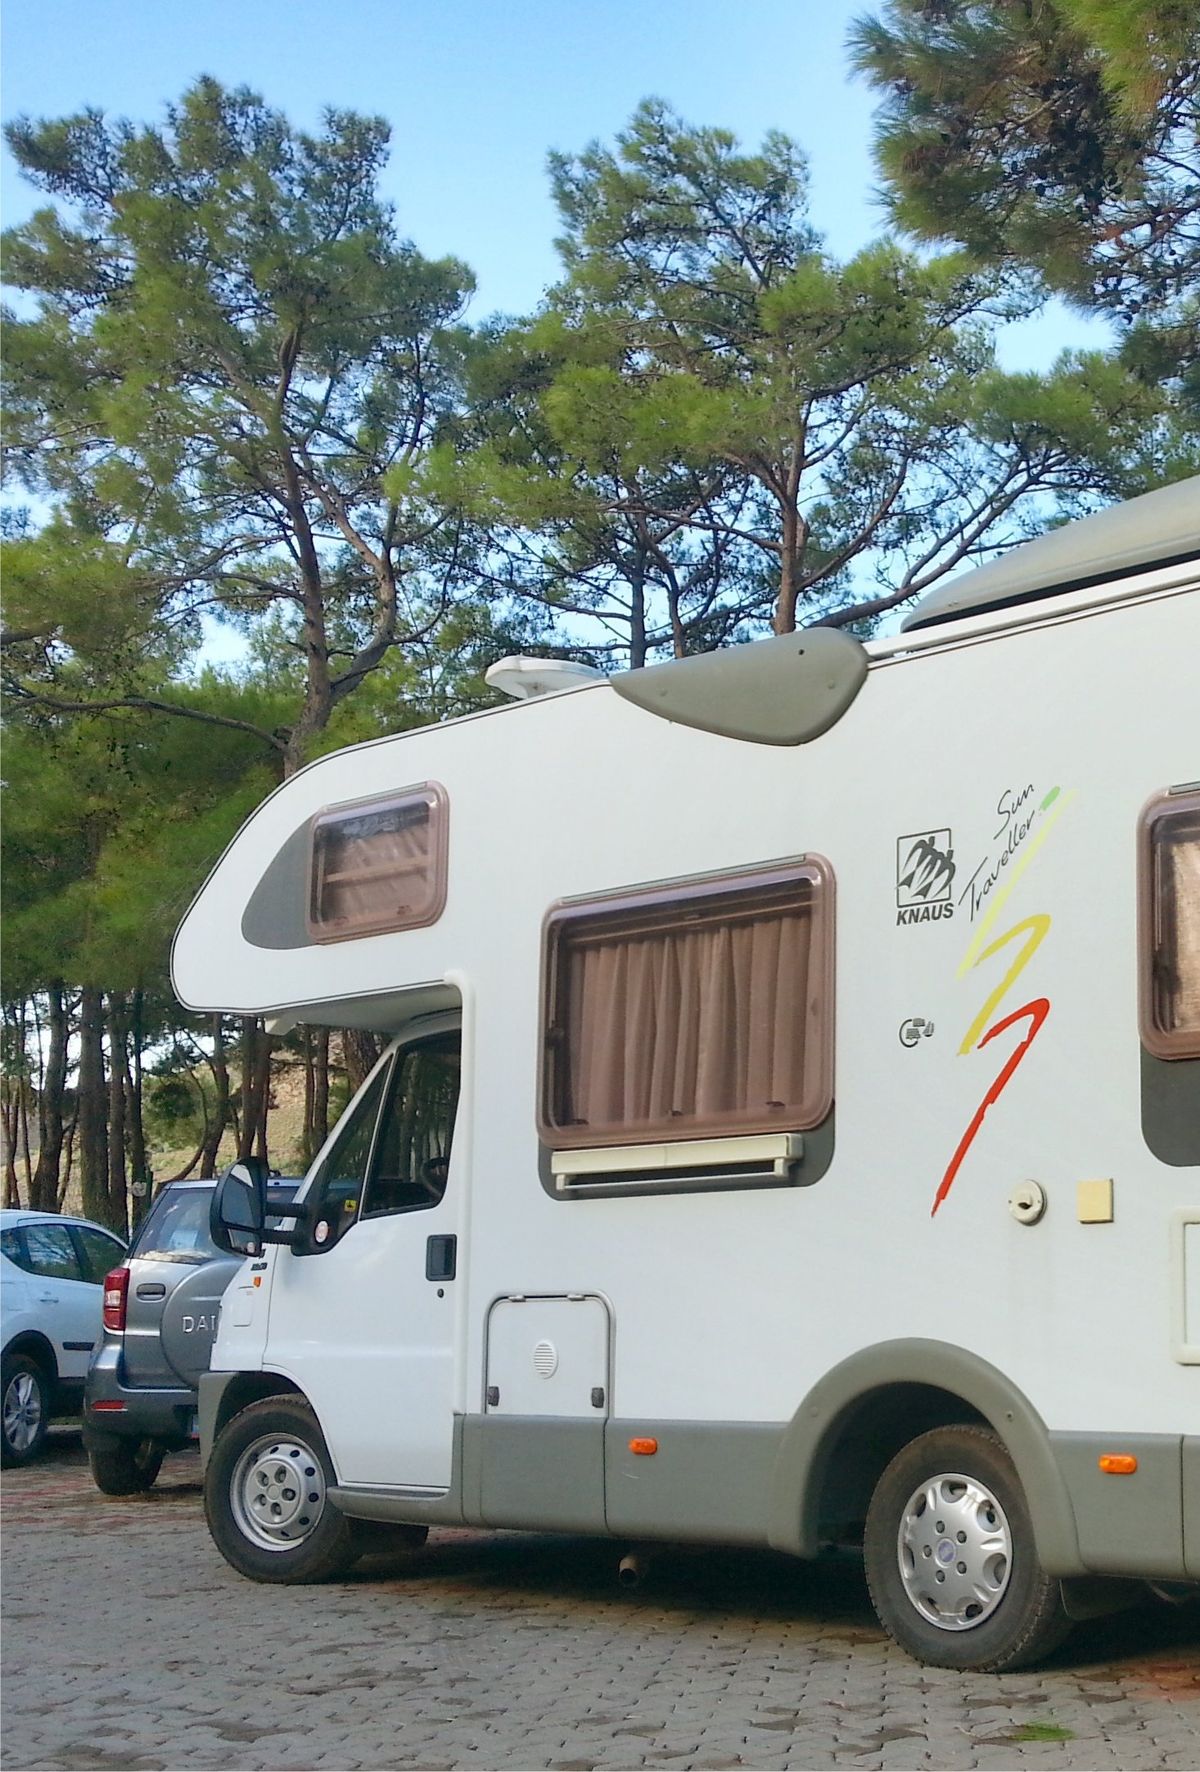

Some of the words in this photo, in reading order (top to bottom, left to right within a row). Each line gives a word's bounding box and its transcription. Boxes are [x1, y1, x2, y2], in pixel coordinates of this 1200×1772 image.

[993, 784, 1034, 840] Sun
[958, 810, 1035, 922] Traveller
[896, 902, 954, 926] KNAUS
